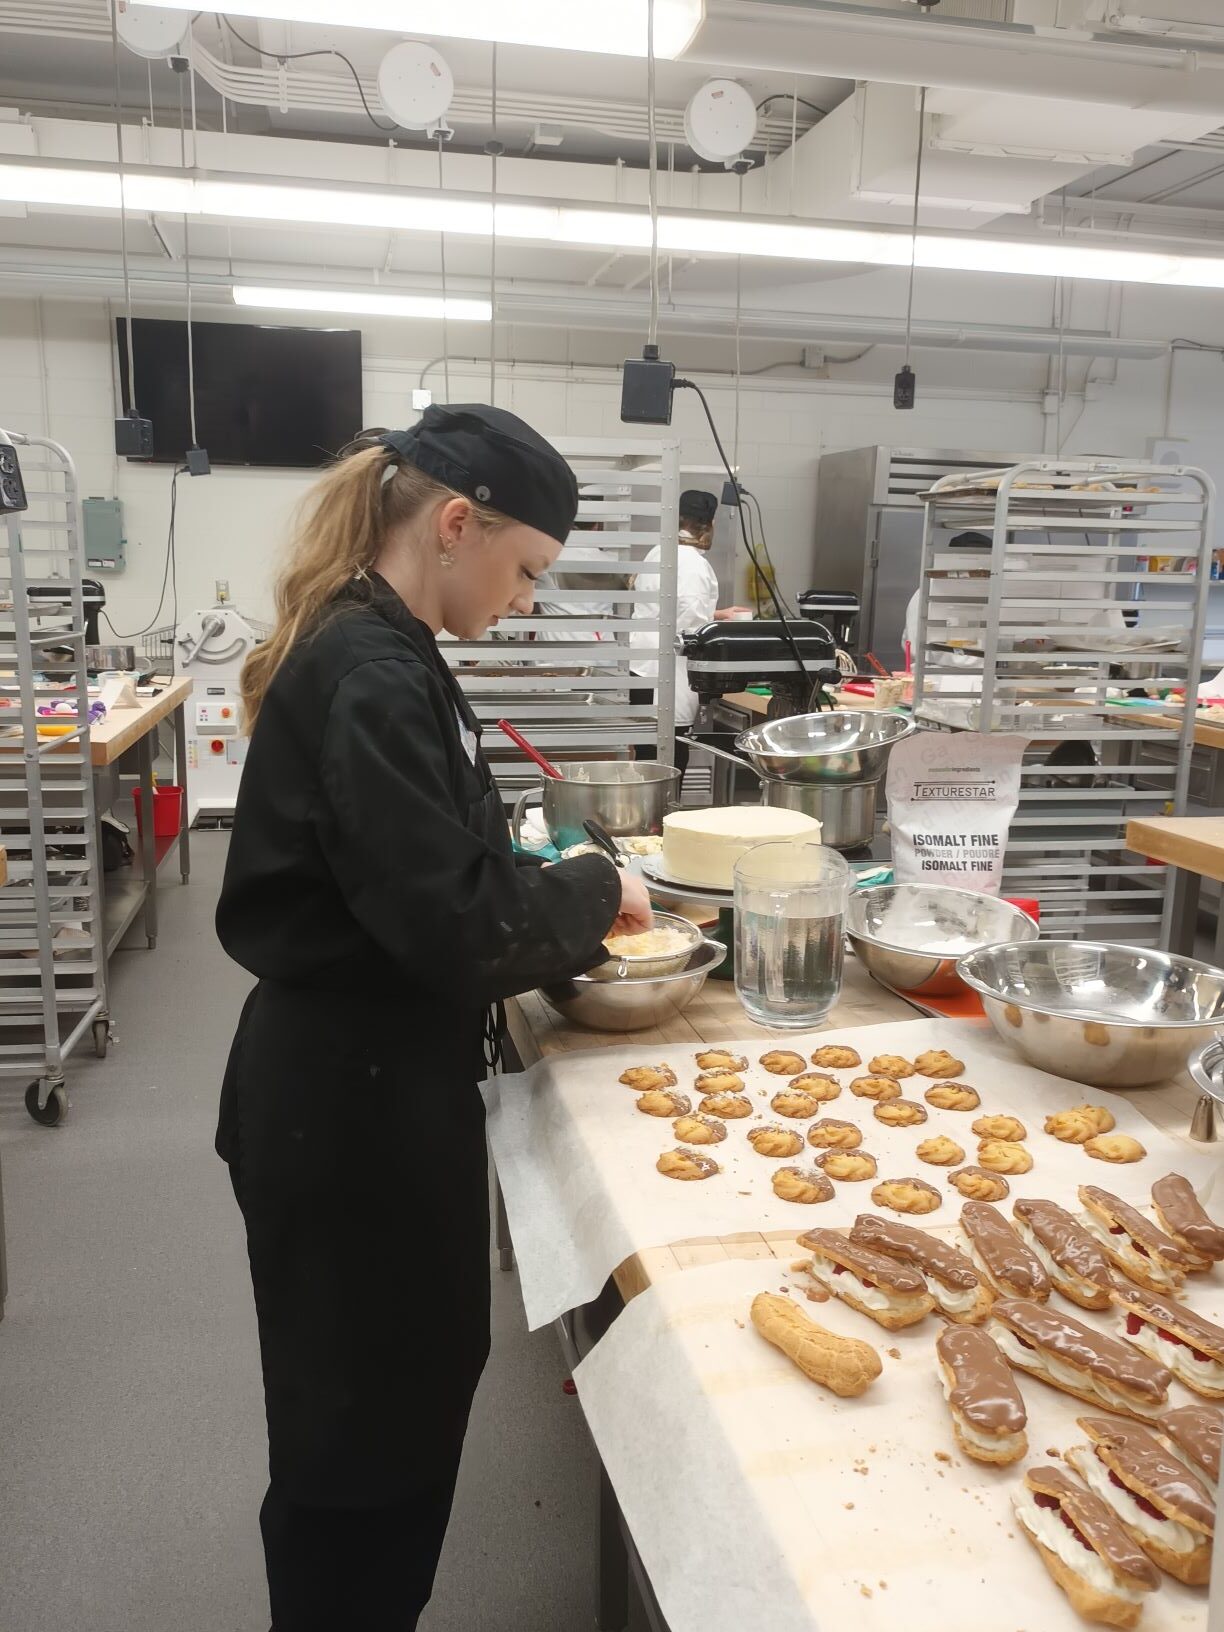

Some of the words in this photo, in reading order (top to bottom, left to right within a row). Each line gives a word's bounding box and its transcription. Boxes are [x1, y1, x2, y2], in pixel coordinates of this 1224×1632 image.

[913, 784, 996, 798] TEXTURESTAR
[913, 834, 967, 846] ISOMALT
[970, 834, 999, 846] FINE
[914, 848, 953, 858] POWDER
[963, 849, 1000, 859] POUDRE
[921, 860, 968, 872] ISOMALT
[970, 861, 993, 872] FINE
